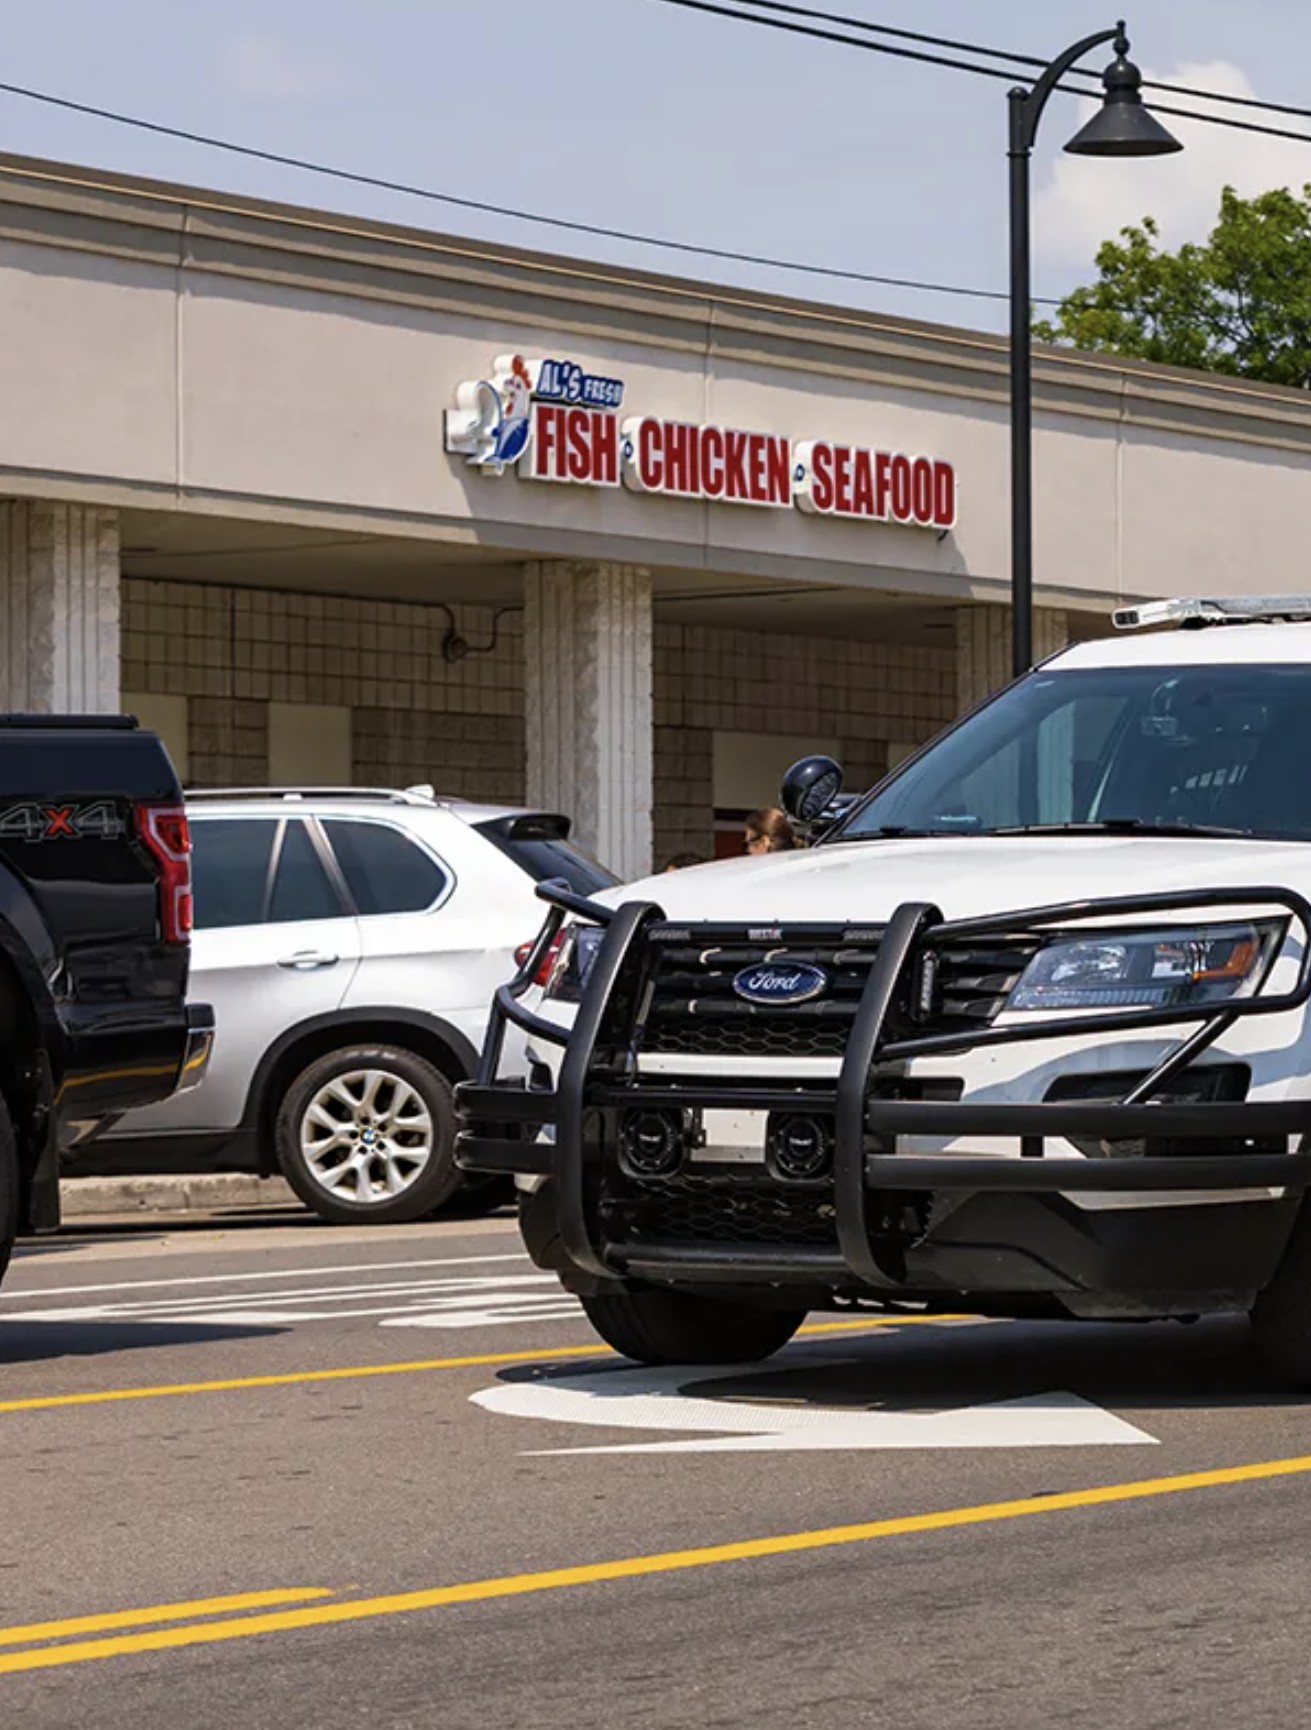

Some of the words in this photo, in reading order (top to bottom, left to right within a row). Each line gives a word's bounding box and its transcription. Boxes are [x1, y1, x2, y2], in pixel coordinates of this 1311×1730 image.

[538, 361, 581, 400] AL'S
[537, 405, 616, 483] FISH
[639, 419, 788, 504] CHICKEN
[812, 442, 954, 525] SEAFOOD
[749, 971, 801, 991] Ford
